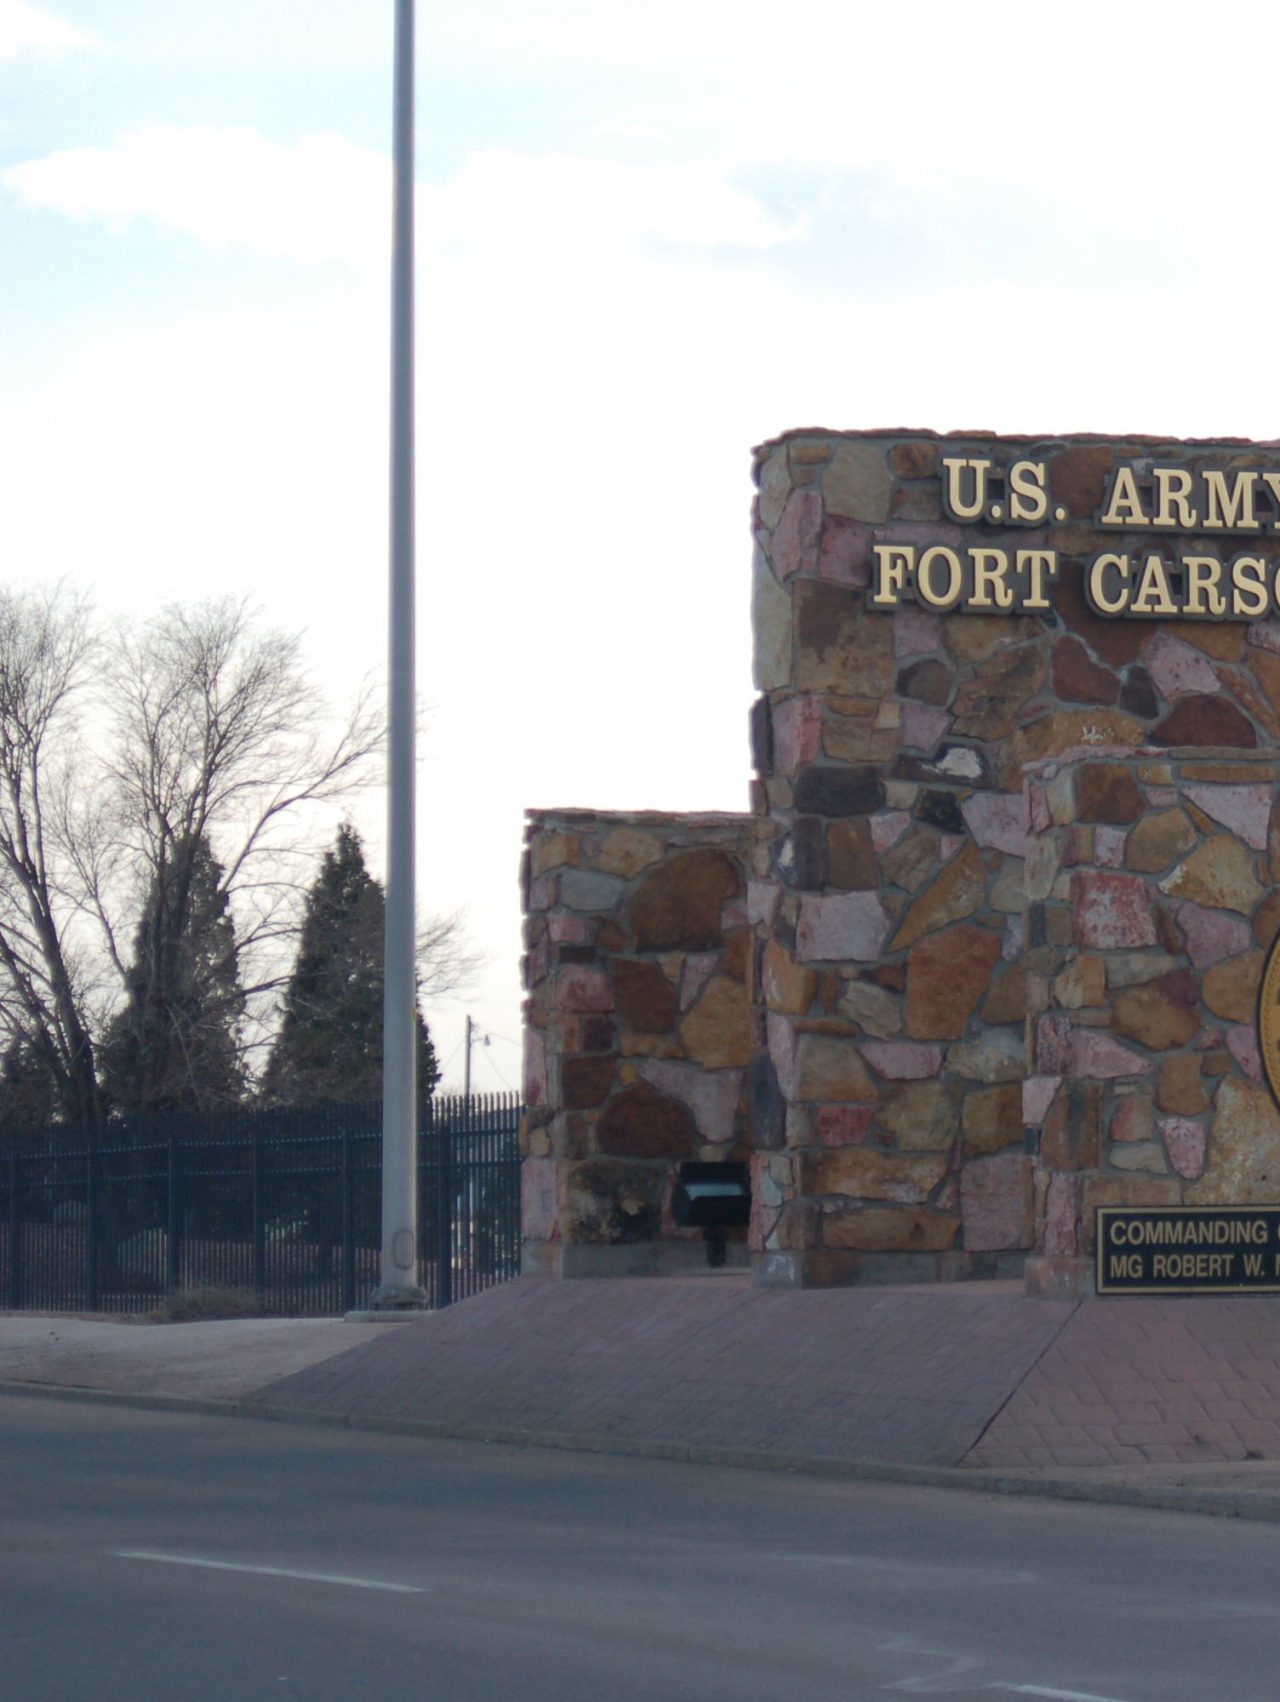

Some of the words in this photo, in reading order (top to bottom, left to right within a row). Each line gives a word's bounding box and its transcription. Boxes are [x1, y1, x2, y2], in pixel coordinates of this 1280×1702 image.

[942, 458, 1066, 521] U.S.
[873, 545, 1056, 607] FORT
[1109, 1219, 1268, 1246] COMMANDING
[1110, 1254, 1143, 1278] MG
[1153, 1254, 1234, 1278] ROBERT
[1242, 1254, 1265, 1277] W.
